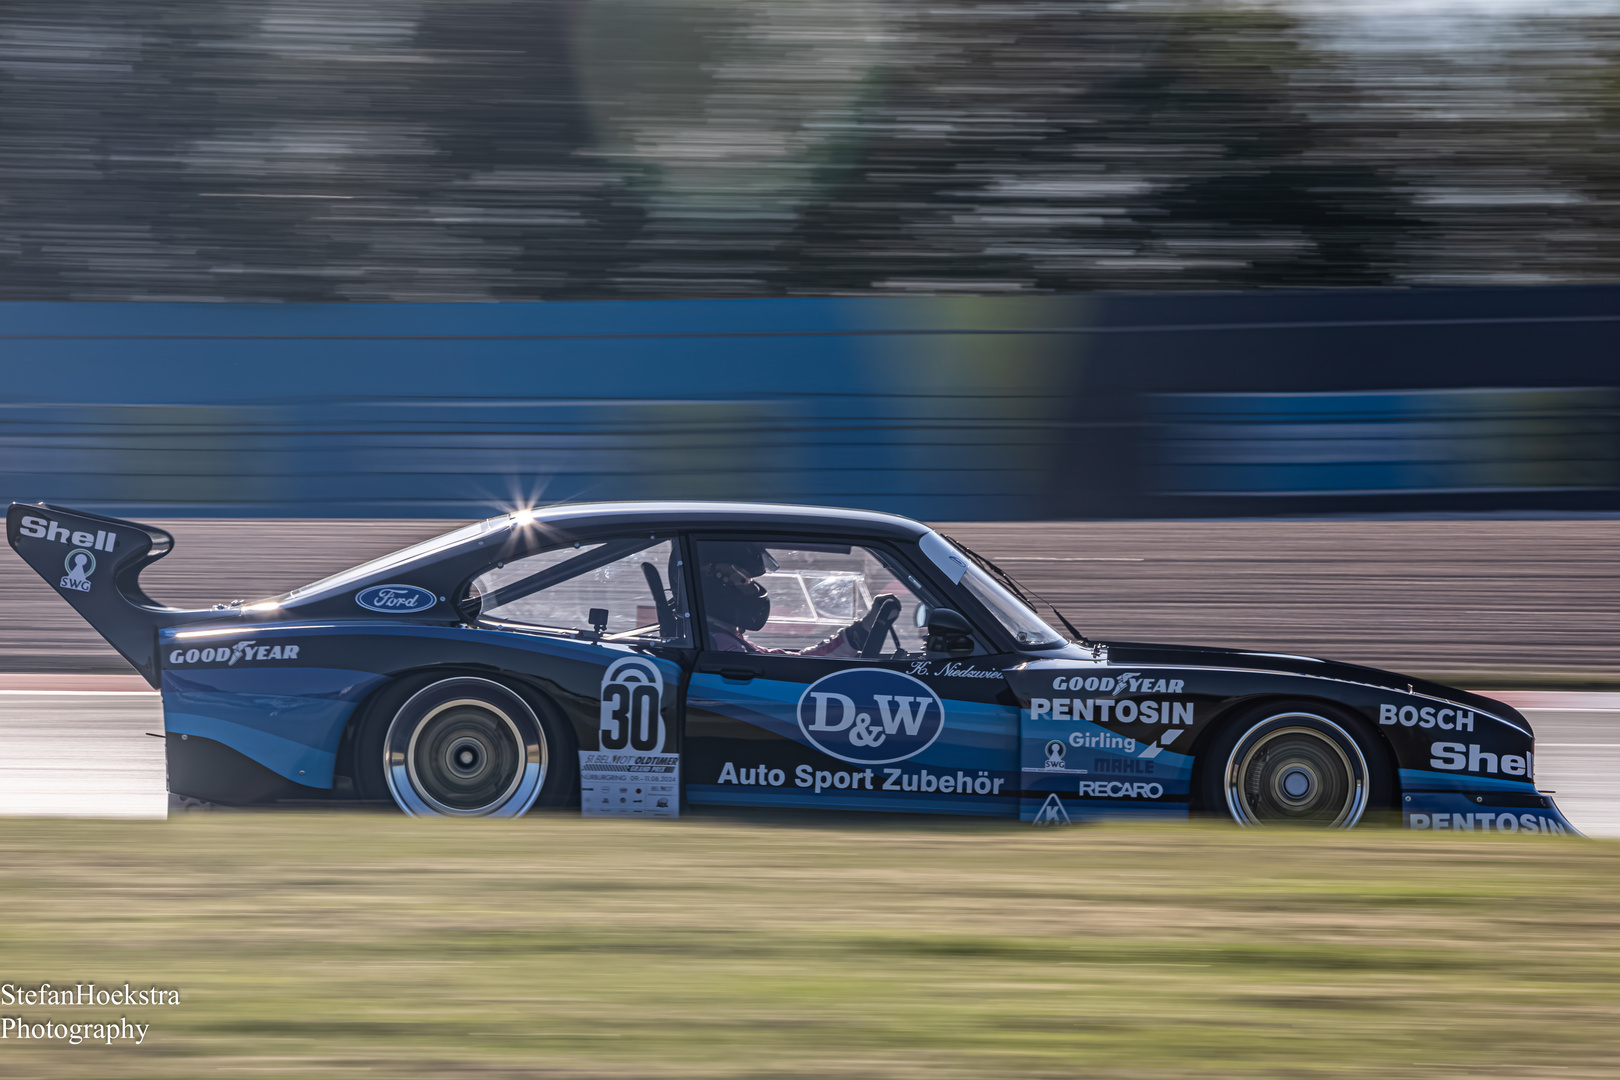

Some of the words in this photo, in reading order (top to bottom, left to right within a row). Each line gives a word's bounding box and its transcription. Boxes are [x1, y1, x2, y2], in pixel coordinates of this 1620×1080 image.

[20, 516, 117, 553] Shell
[61, 577, 91, 591] SWG
[373, 589, 420, 608] Ford
[905, 661, 931, 675] K.
[601, 683, 660, 752] 30
[808, 691, 934, 748] D&W
[1030, 698, 1194, 726] PENTOSIN
[1379, 703, 1475, 732] BOSCH
[1068, 732, 1136, 753] Girling
[635, 756, 679, 766] OLDTIMER
[1045, 760, 1065, 769] SWG
[1093, 757, 1155, 774] MAHLE
[1430, 741, 1535, 779] Shel
[717, 762, 786, 787] Auto
[794, 764, 874, 794] Sport
[882, 767, 1005, 795] Zubehör
[1078, 780, 1163, 799] RECARO
